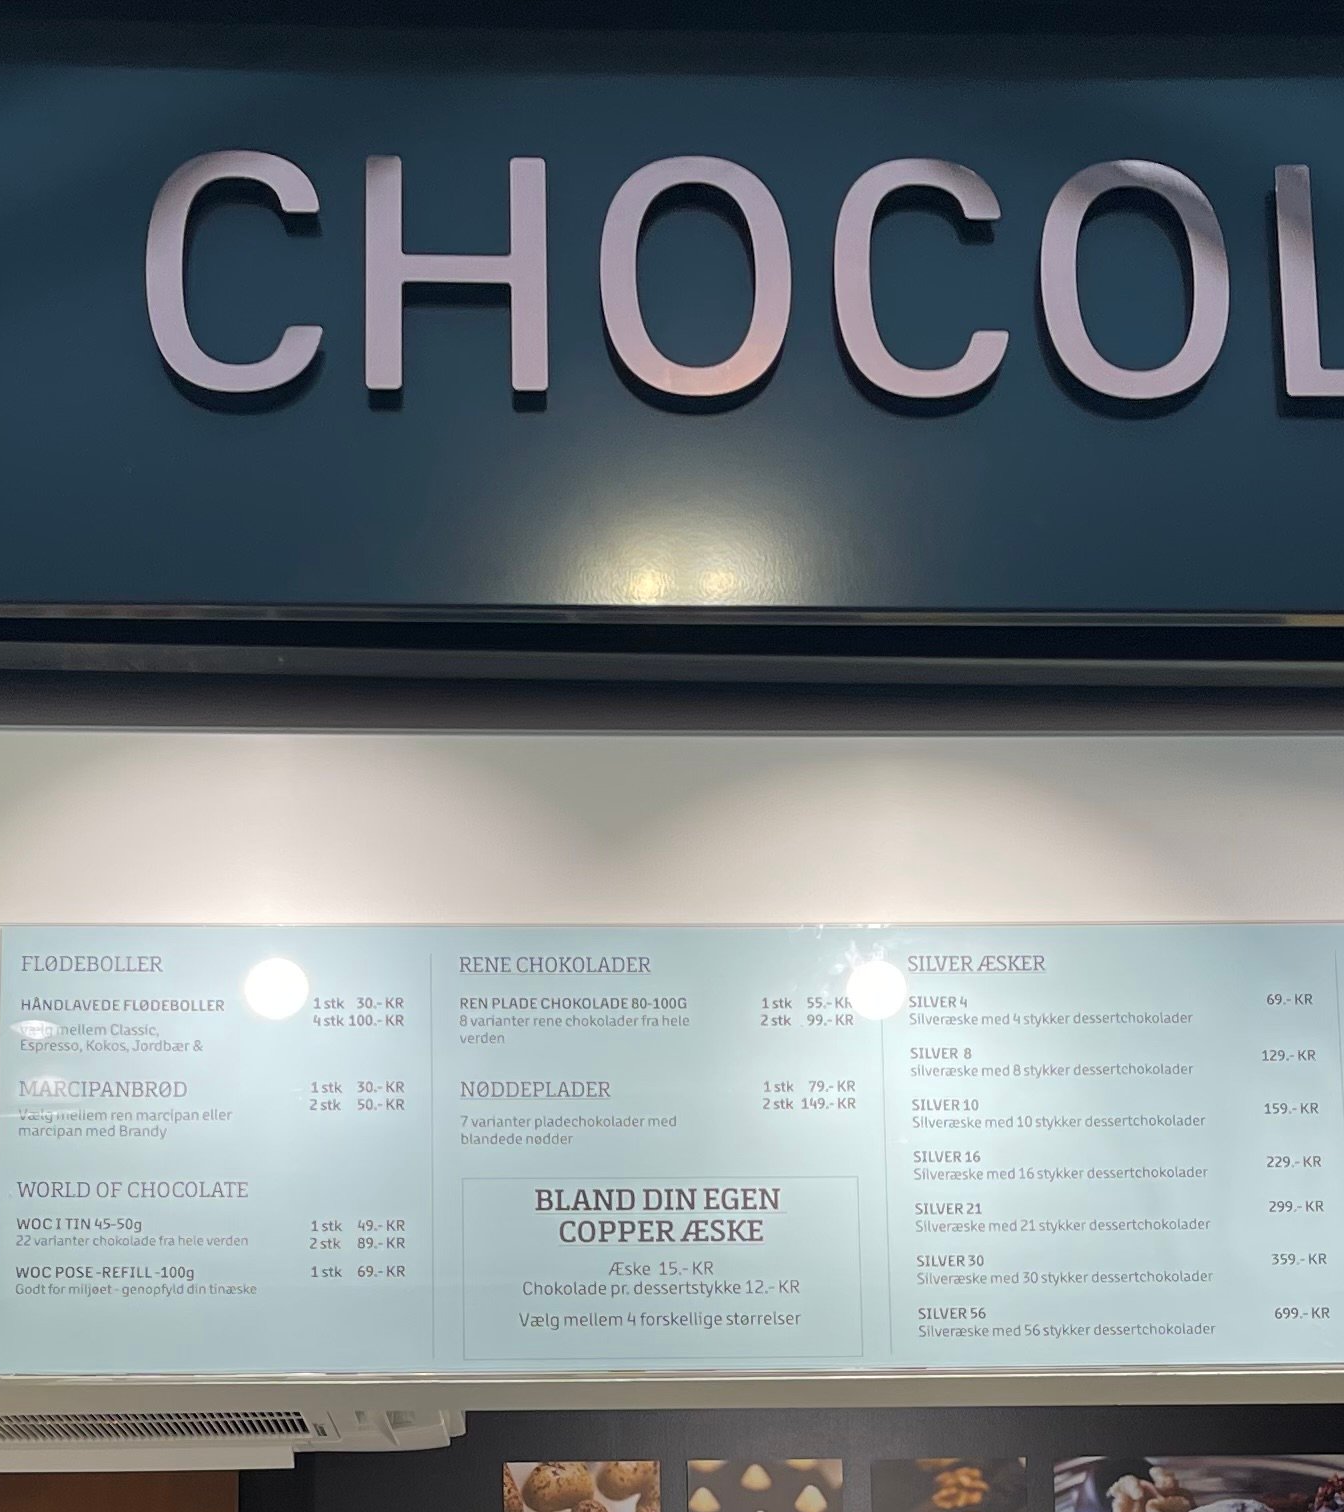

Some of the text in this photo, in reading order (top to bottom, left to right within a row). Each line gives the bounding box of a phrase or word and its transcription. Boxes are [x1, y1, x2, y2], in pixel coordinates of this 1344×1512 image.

[21, 955, 164, 973] FLØDEBOLLER
[459, 956, 652, 974] RENE CHOKOLADER
[907, 954, 1046, 974] SILVER ÆSKER
[20, 996, 225, 1013] HÅNDLAVEDE FLØDEBOLLER
[312, 996, 405, 1010] 1 stk 30.- KR
[459, 996, 688, 1010] REN PLADE CHOKOLADE 80-100G
[908, 995, 968, 1009] SILVER 4
[1266, 993, 1313, 1006] 69.- KR
[312, 1013, 405, 1028] 4 stk 100.- KR
[458, 1013, 691, 1028] 8 varianter rene chokolader fra hele
[459, 1031, 506, 1045] verden
[18, 1080, 188, 1099] MARCIPANBRØD
[460, 1080, 612, 1098] NØDDEPLADER
[762, 1096, 857, 1111] 2 stk 149.- KR
[911, 1098, 980, 1112] SILVER 10
[1264, 1102, 1320, 1115] 159.- KR
[17, 1123, 168, 1141] marcipan med Brandy
[16, 1180, 249, 1199] WORLD OF CHOCOLATE
[534, 1187, 781, 1212] BLAND DIN EGEN
[16, 1217, 143, 1234] WOC I TIN 45-50g
[311, 1219, 406, 1233] 1 stk 49.- KR
[559, 1218, 764, 1244] COPPER ÆSKE
[608, 1260, 714, 1277] Æske 15.- KR
[522, 1279, 801, 1299] Chokolade pr. dessertstykke 12.- KR
[518, 1310, 802, 1331] Vælg mellem 4 forskellige størrelser
[917, 1306, 987, 1320] SILVER 56
[1274, 1306, 1331, 1320] 699.- KR
